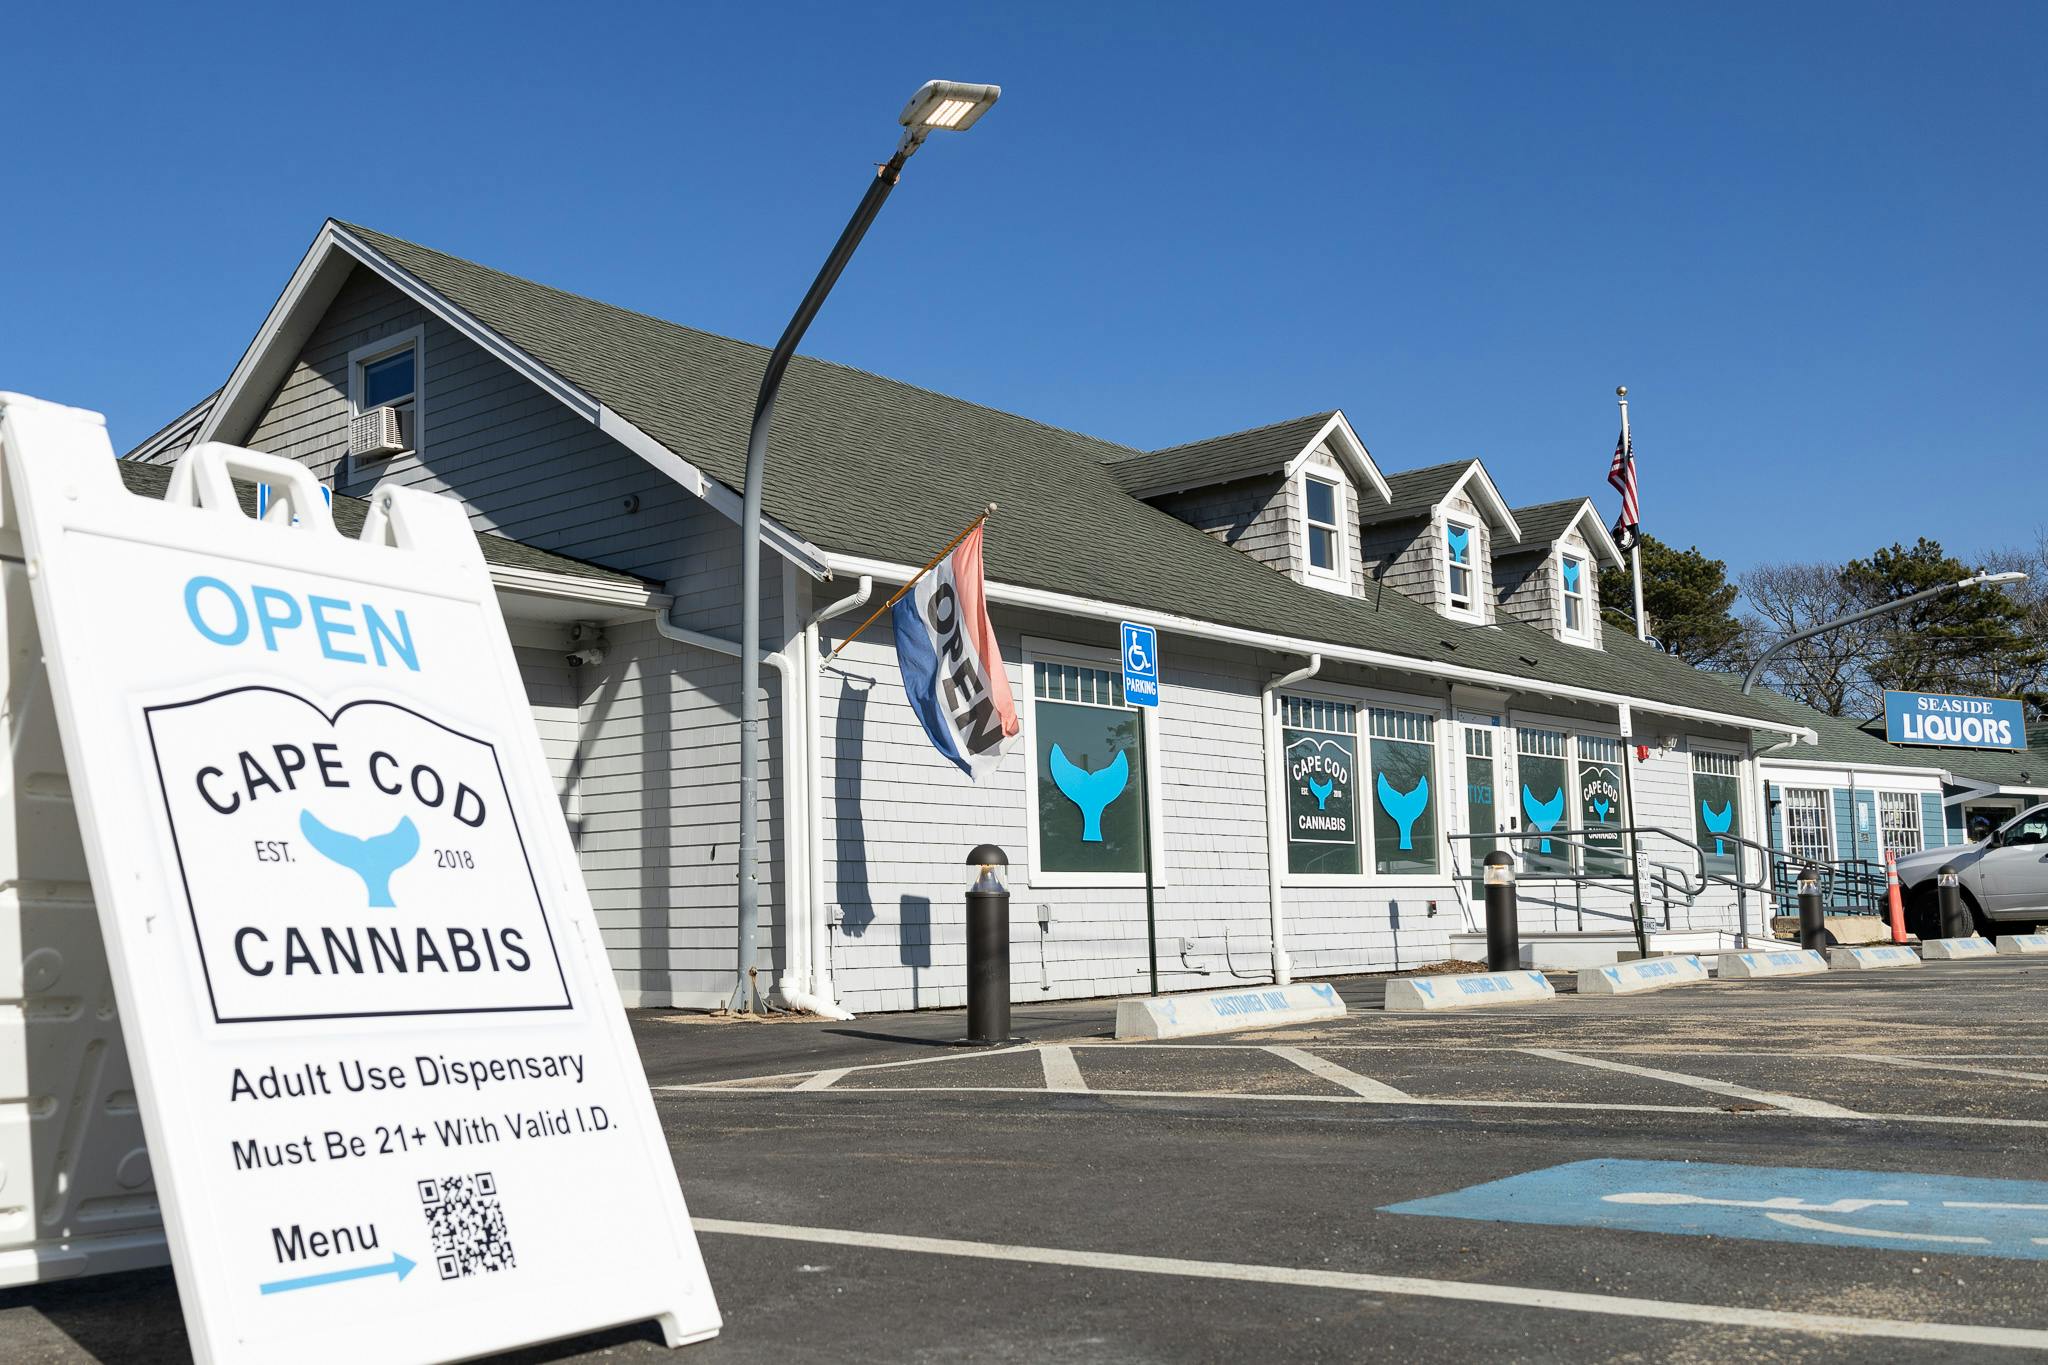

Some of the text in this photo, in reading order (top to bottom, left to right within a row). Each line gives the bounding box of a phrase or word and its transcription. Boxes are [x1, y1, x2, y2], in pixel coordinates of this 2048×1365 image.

[184, 576, 421, 672] OPEN
[927, 583, 1006, 756] OPEN
[1126, 677, 1156, 696] PARKING
[1917, 697, 1993, 715] SEASIDE
[1903, 713, 2012, 745] LIQUORS
[196, 742, 486, 828] CAPE COD
[1293, 755, 1348, 785] CAPE COD
[1583, 780, 1618, 803] CAPE COD
[1299, 815, 1346, 832] CANNABIS
[254, 841, 475, 869] EST. 2018
[234, 926, 531, 977] CANNABIS
[230, 1054, 584, 1102] Adult Use Dispensary
[231, 1106, 618, 1171] Must Be 21+ With Valid I.D.
[271, 1223, 379, 1264] Menu
